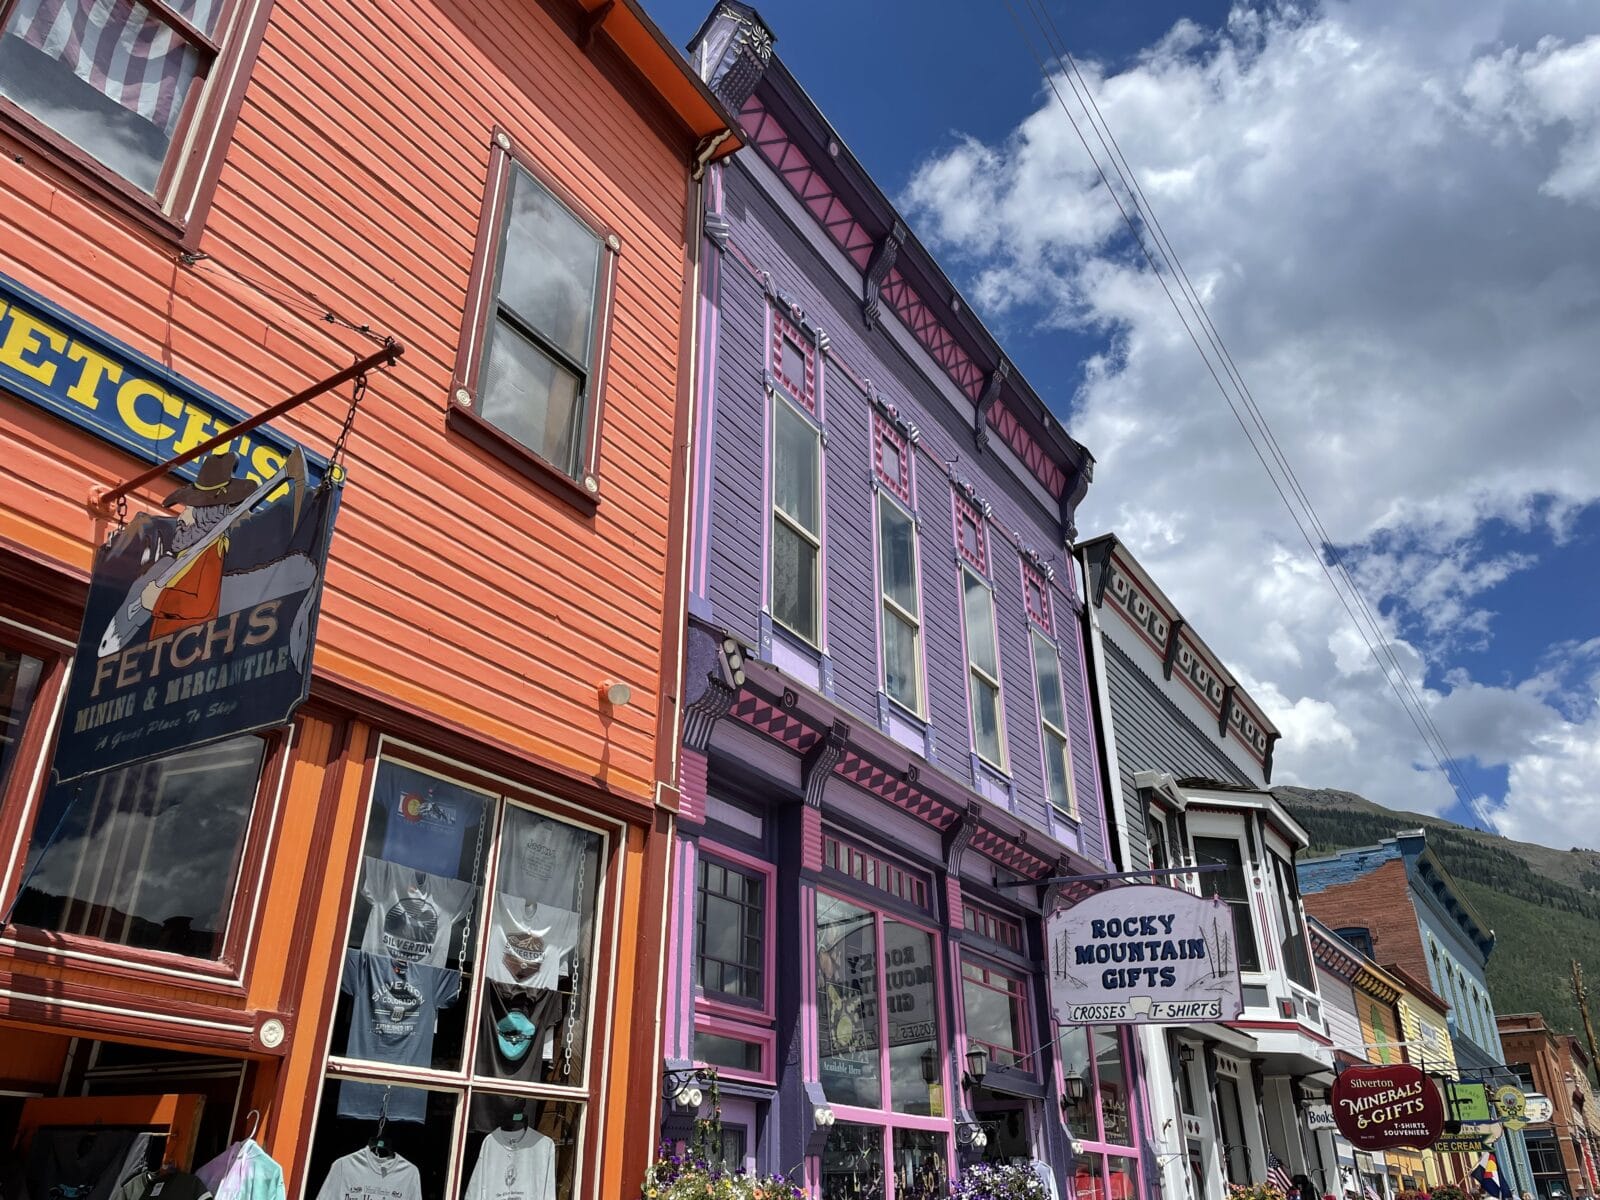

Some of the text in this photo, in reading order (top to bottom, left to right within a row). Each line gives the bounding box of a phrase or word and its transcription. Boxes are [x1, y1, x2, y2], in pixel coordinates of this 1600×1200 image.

[0, 296, 290, 503] ETCH'S
[74, 645, 290, 734] MINING & MERCANTILE
[111, 726, 144, 749] Great
[148, 718, 179, 736] Place
[206, 700, 237, 719] Shop
[1091, 914, 1176, 939] ROCKY
[383, 935, 432, 954] SILVERTON
[1075, 938, 1206, 965] MOUNTAIN
[1102, 966, 1177, 990] GIFTS
[372, 980, 424, 1006] SILVERTON
[1073, 1005, 1127, 1020] CROSSES
[1351, 1079, 1394, 1089] Silverton
[1340, 1080, 1423, 1116] MINERALS
[1357, 1098, 1425, 1129] & GIFTS
[1435, 1141, 1482, 1151] ICE CREAM
